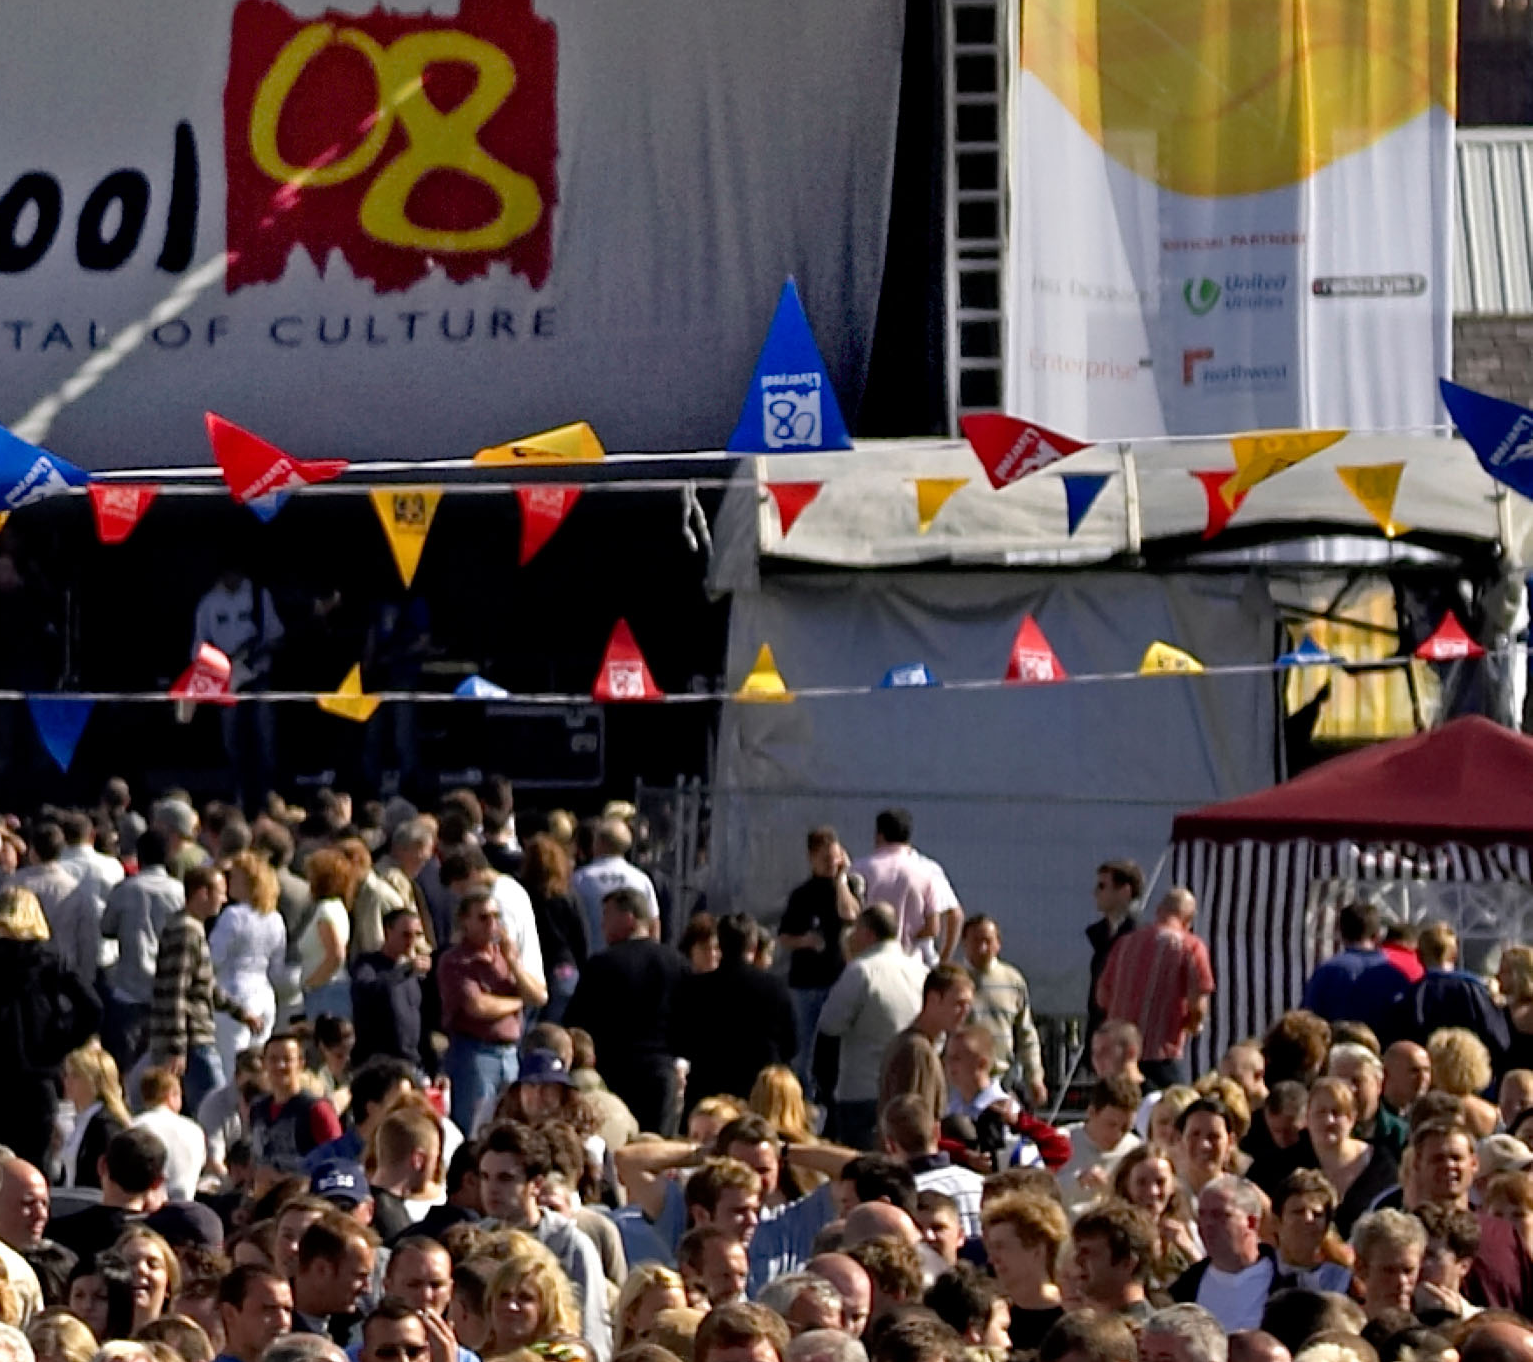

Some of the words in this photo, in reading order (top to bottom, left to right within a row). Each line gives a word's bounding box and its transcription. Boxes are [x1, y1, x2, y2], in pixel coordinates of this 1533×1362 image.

[250, 23, 543, 253] 08
[151, 316, 233, 347] OF
[269, 306, 559, 346] CULTURE
[769, 399, 816, 440] 08
